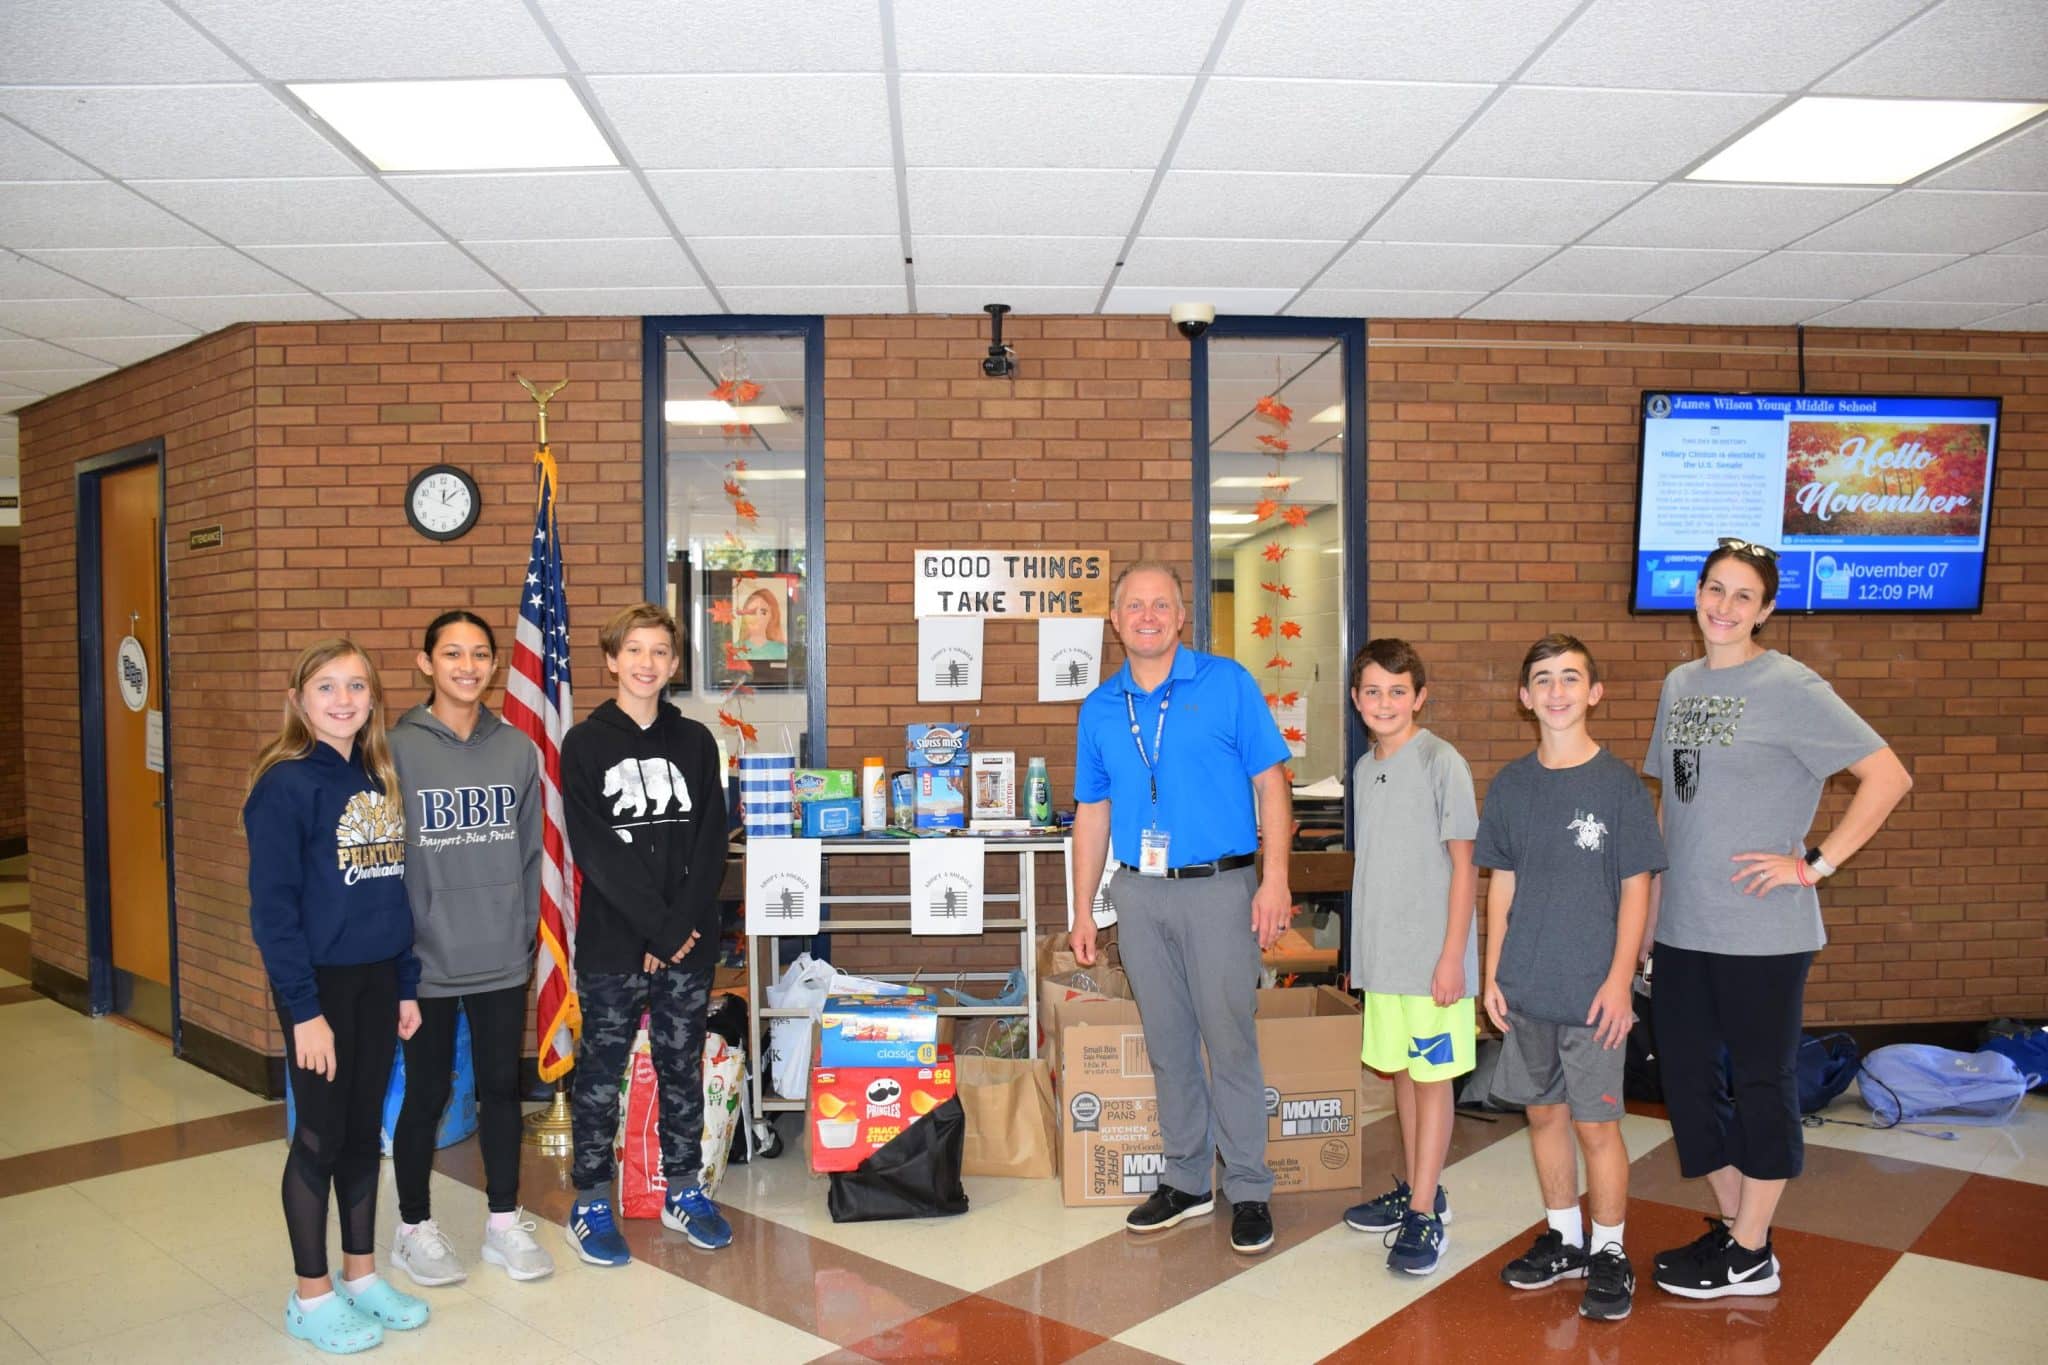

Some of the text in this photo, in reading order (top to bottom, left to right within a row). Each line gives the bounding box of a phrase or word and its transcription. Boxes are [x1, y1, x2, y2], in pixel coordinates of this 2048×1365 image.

[1674, 398, 1877, 414] James Wilson Young Middle School
[1839, 437, 1938, 477] Hello
[1796, 482, 1972, 521] November
[924, 556, 1100, 579] GOOD THINGS
[1843, 562, 1949, 578] November 07
[937, 590, 1084, 613] TAKE TIME
[1858, 584, 1934, 600] 12:09 PM
[418, 784, 516, 832] BBP
[418, 829, 516, 854] Bayport-Blue Point
[337, 844, 405, 870] PHANTOM
[344, 862, 405, 886] Cheerleading
[877, 1049, 916, 1059] classic
[922, 1047, 932, 1058] 18
[934, 1069, 951, 1079] 60
[866, 1103, 901, 1119] PRINGLES
[1104, 1101, 1133, 1110] POTS
[1135, 1101, 1143, 1111] &
[1107, 1111, 1136, 1120] PANS
[1283, 1099, 1341, 1120] MOVER
[868, 1126, 901, 1135] SNACK
[1321, 1117, 1349, 1133] one
[1094, 1144, 1106, 1195] SUPPLIES
[1107, 1150, 1119, 1187] OFFICE
[1123, 1154, 1167, 1174] MOV
